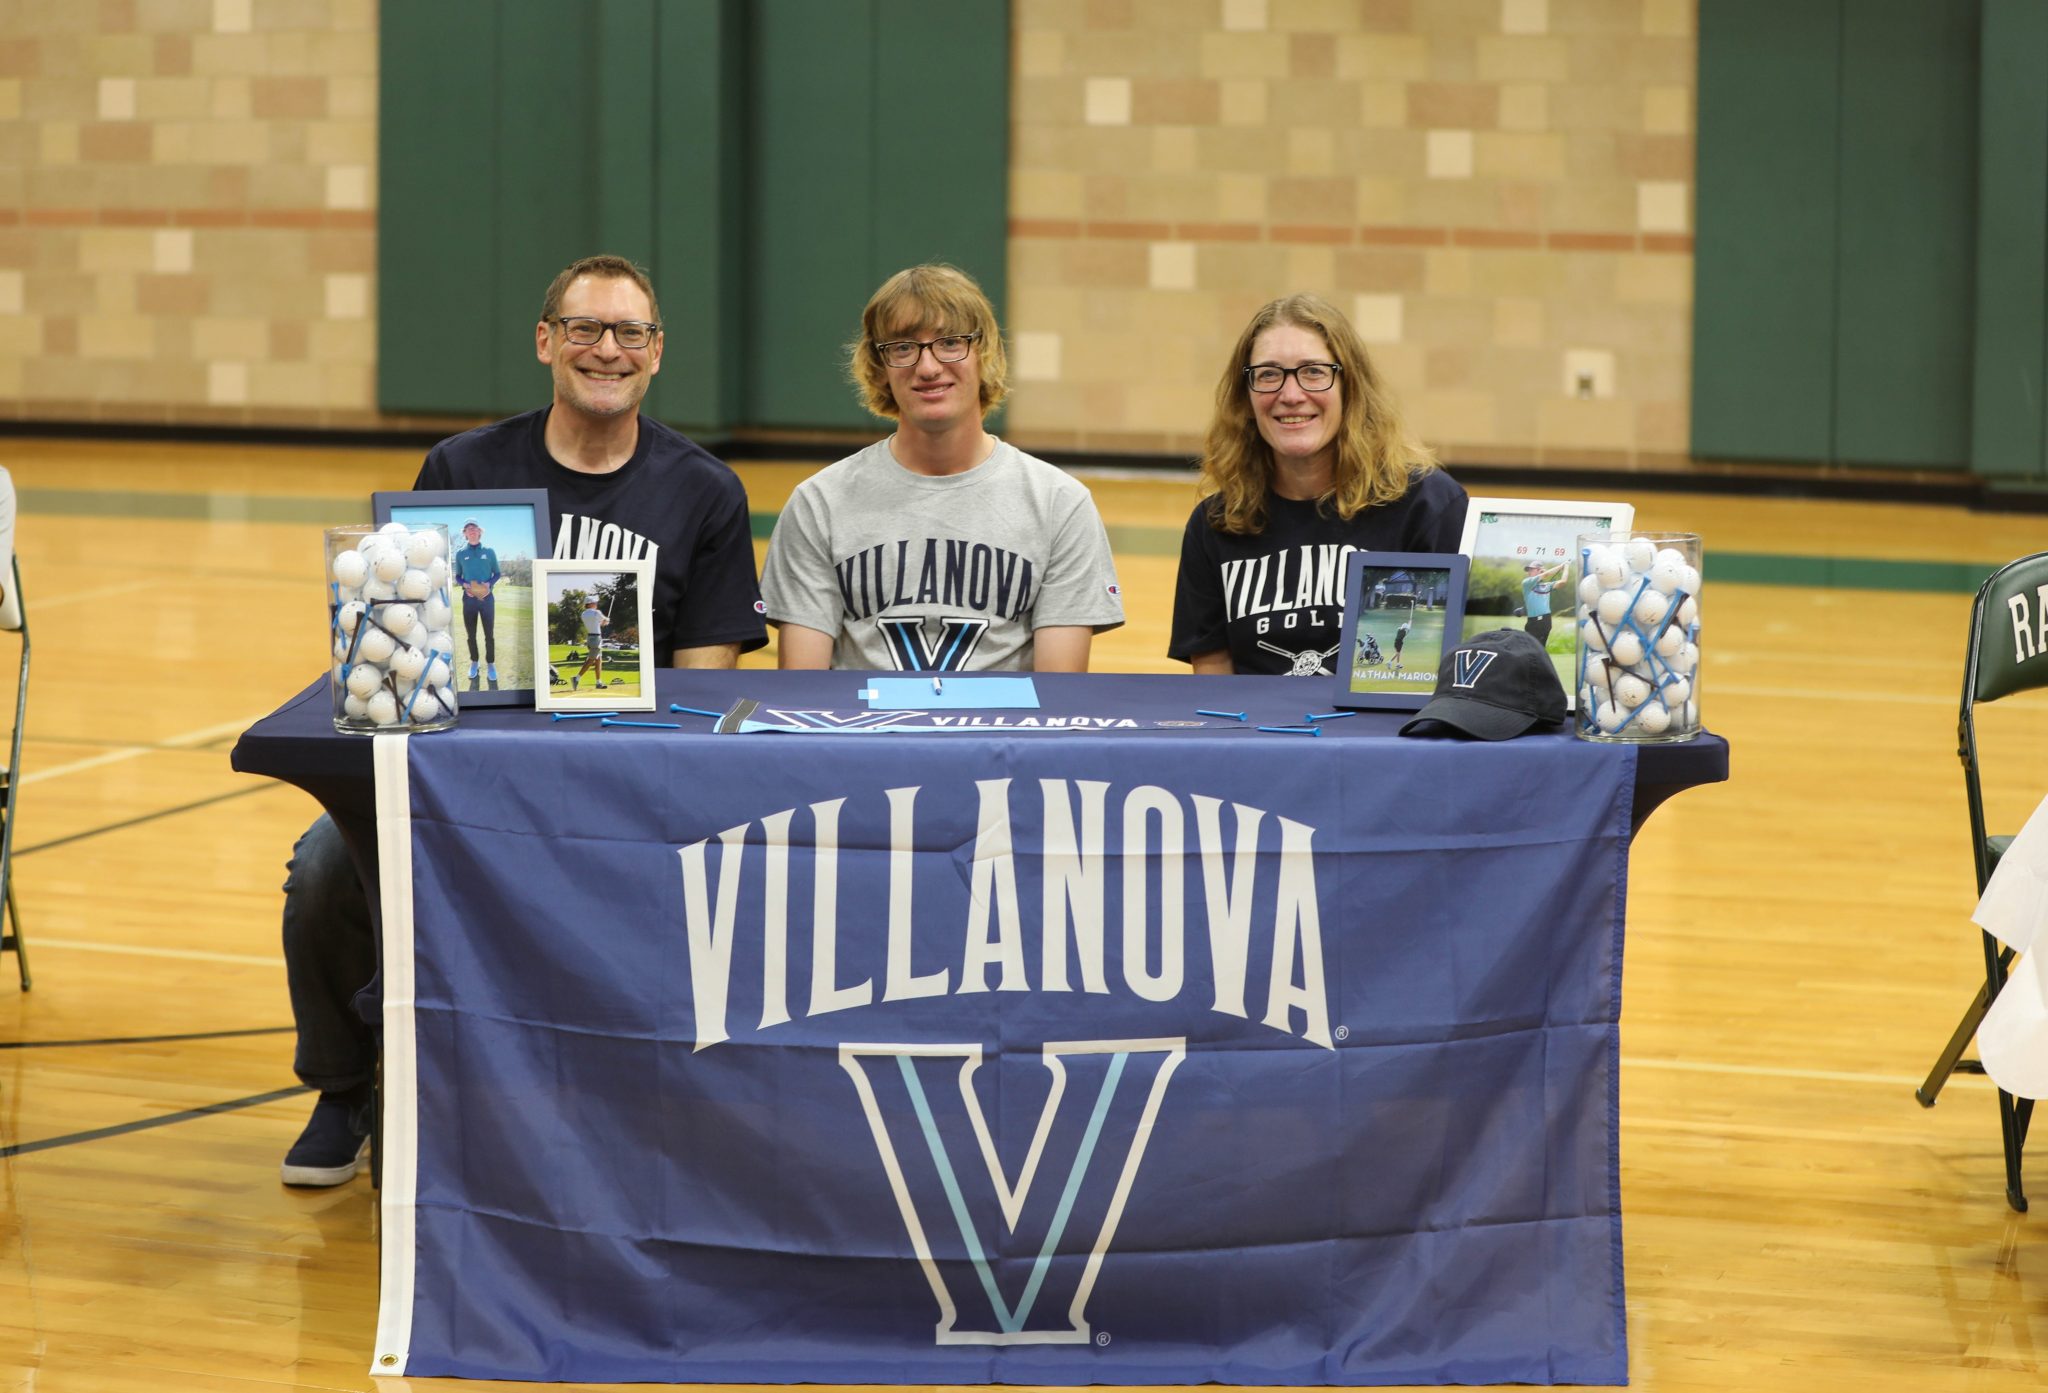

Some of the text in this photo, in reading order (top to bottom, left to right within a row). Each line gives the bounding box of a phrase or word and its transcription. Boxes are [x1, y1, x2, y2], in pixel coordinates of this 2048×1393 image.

[1516, 545, 1566, 557] 69 71 69
[834, 538, 1033, 622] VILLANOVA
[1220, 544, 1368, 623] VILLANO
[876, 616, 990, 671] V
[1452, 649, 1498, 689] V
[1352, 670, 1439, 682] NATHAN MARION
[931, 716, 1140, 729] VILLANOVA
[677, 777, 1336, 1054] VILLANOVA
[838, 1036, 1187, 1346] V
